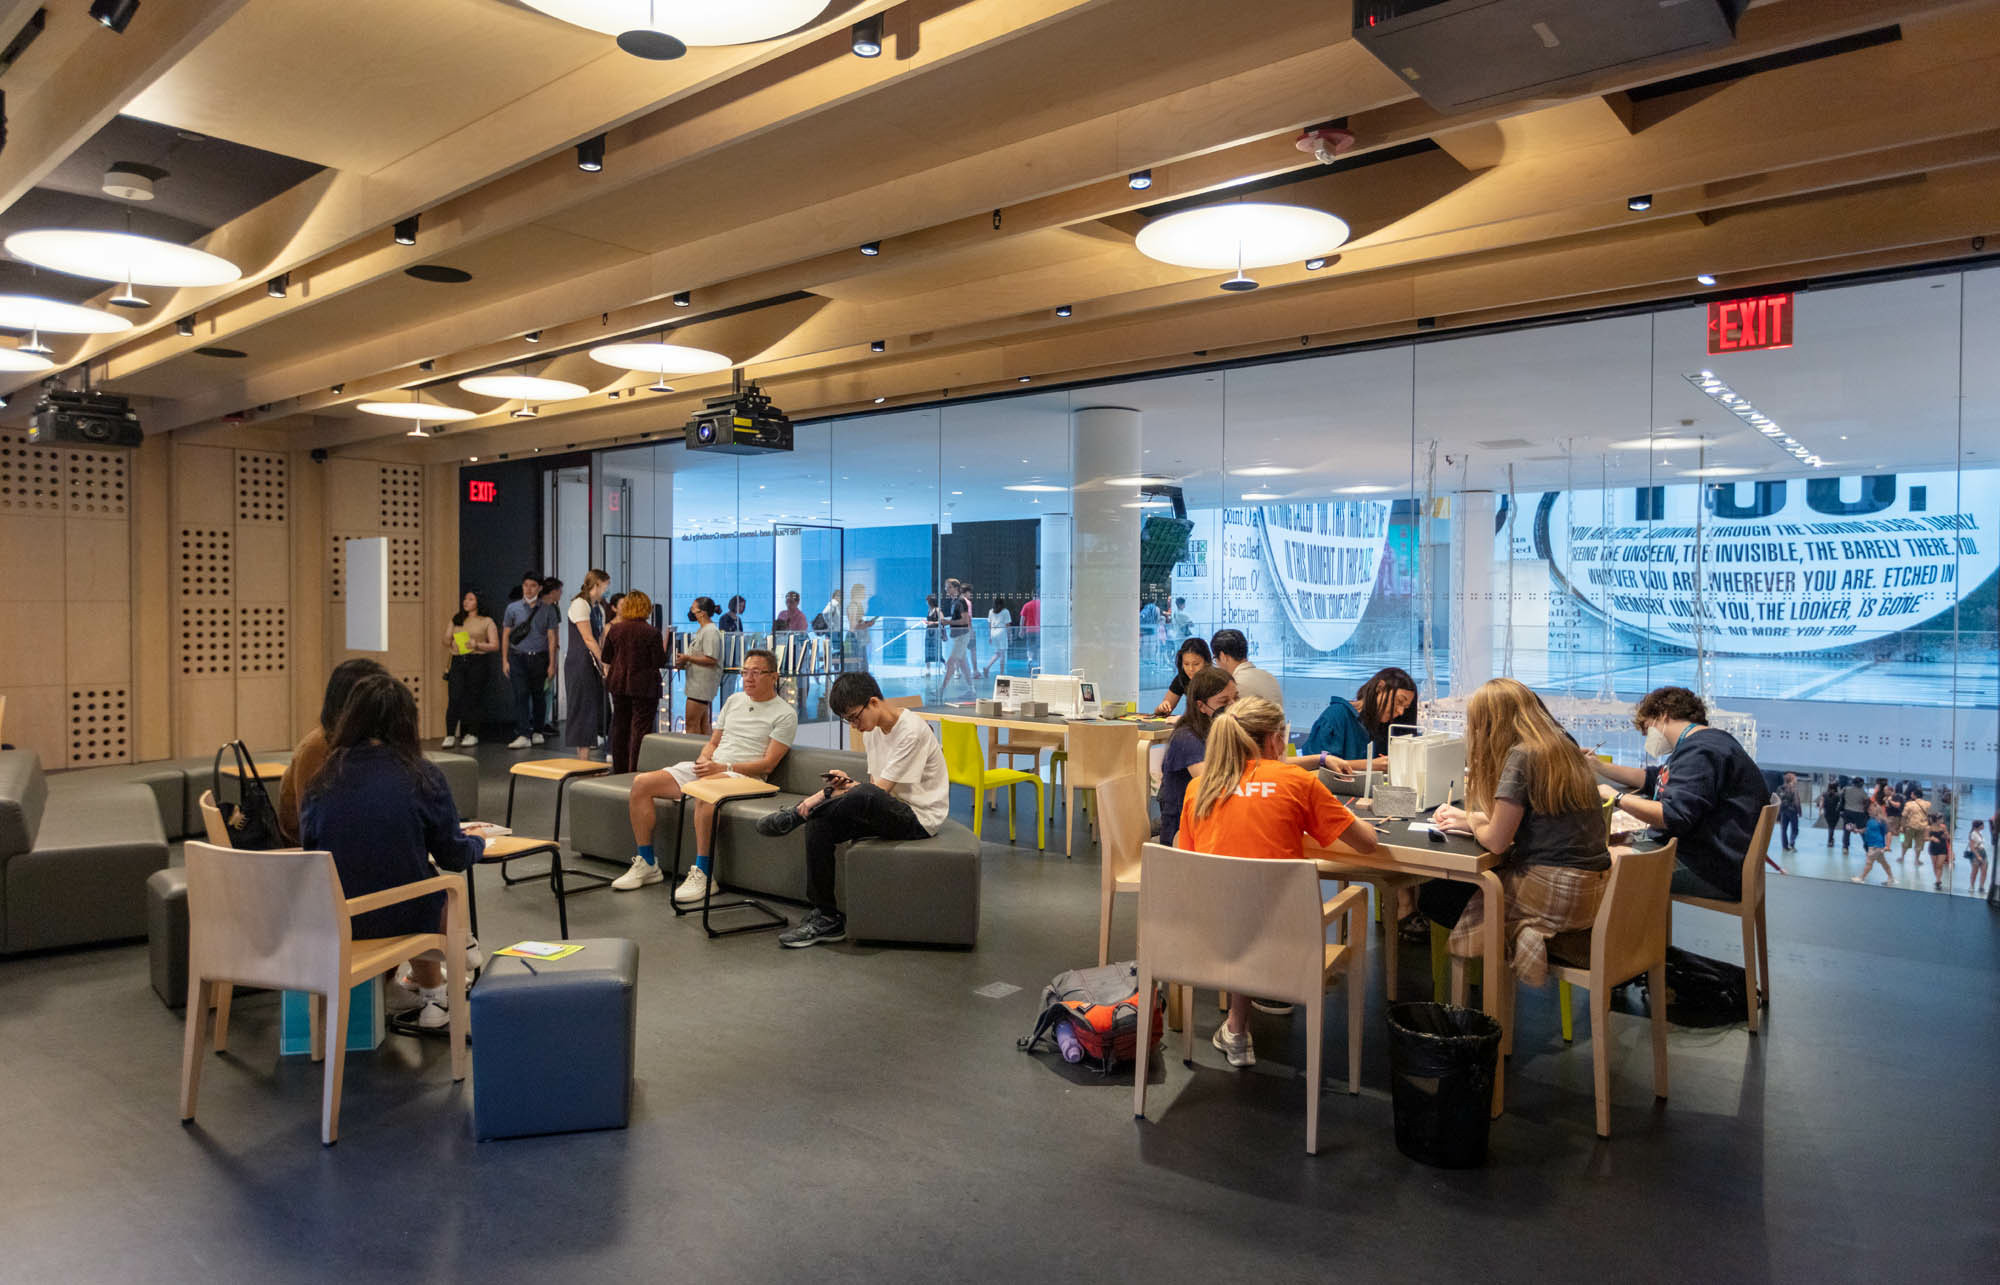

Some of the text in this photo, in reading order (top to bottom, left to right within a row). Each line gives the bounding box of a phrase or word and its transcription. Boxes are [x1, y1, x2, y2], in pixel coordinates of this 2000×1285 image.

[1719, 297, 1787, 349] EXIT
[469, 480, 495, 503] EXIT
[1223, 507, 1243, 530] point
[1571, 525, 1592, 541] YOU
[1774, 523, 1806, 536] THE
[1803, 520, 1877, 536] LOOKING
[1866, 518, 1935, 534] GLASS,
[1229, 534, 1237, 558] is
[1238, 537, 1260, 561] called
[1569, 536, 1980, 566] SEEING THE UNSEEN, THE INVISIBLE, THE BARELY THERE. YOU.
[1228, 567, 1247, 591] from
[1639, 570, 1669, 591] YOU
[1709, 570, 1796, 593] WHEREVER
[1803, 568, 1837, 592] YOU
[1841, 567, 1877, 591] ARE.
[1883, 563, 1938, 589] ETCHED
[1940, 563, 1955, 584] IN
[1228, 600, 1260, 624] between
[1613, 594, 1672, 617] MEMORY.
[1716, 601, 1756, 623] YOU,
[1757, 602, 1786, 621] THE
[1789, 599, 1852, 622] LOOKER,
[1857, 597, 1878, 618] IS
[1876, 594, 1925, 617] GONE.
[1727, 626, 1748, 637] NO
[1796, 625, 1825, 637] YOU
[1228, 782, 1277, 798] AFF
